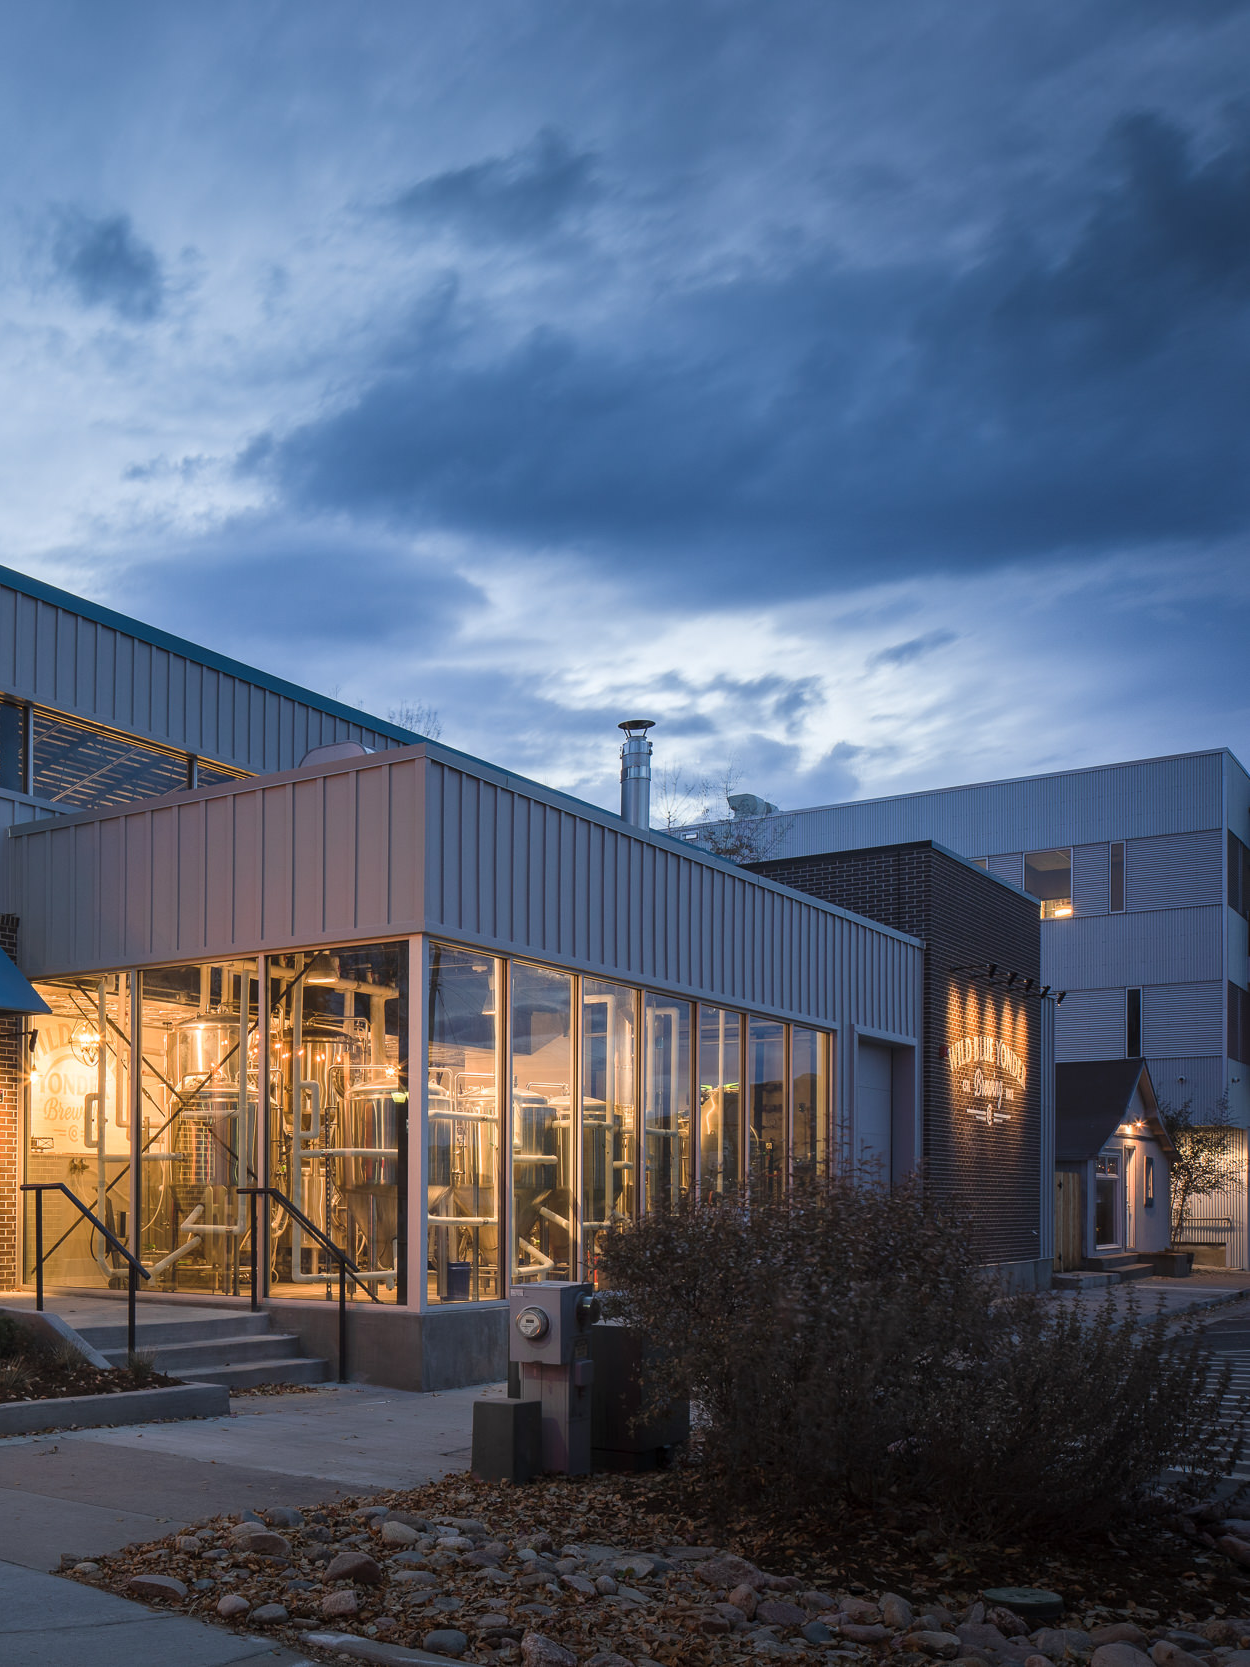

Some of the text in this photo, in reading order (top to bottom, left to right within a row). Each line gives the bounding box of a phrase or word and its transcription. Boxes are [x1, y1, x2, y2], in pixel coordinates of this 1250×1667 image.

[948, 1036, 1027, 1090] WILD BLUE YONDER
